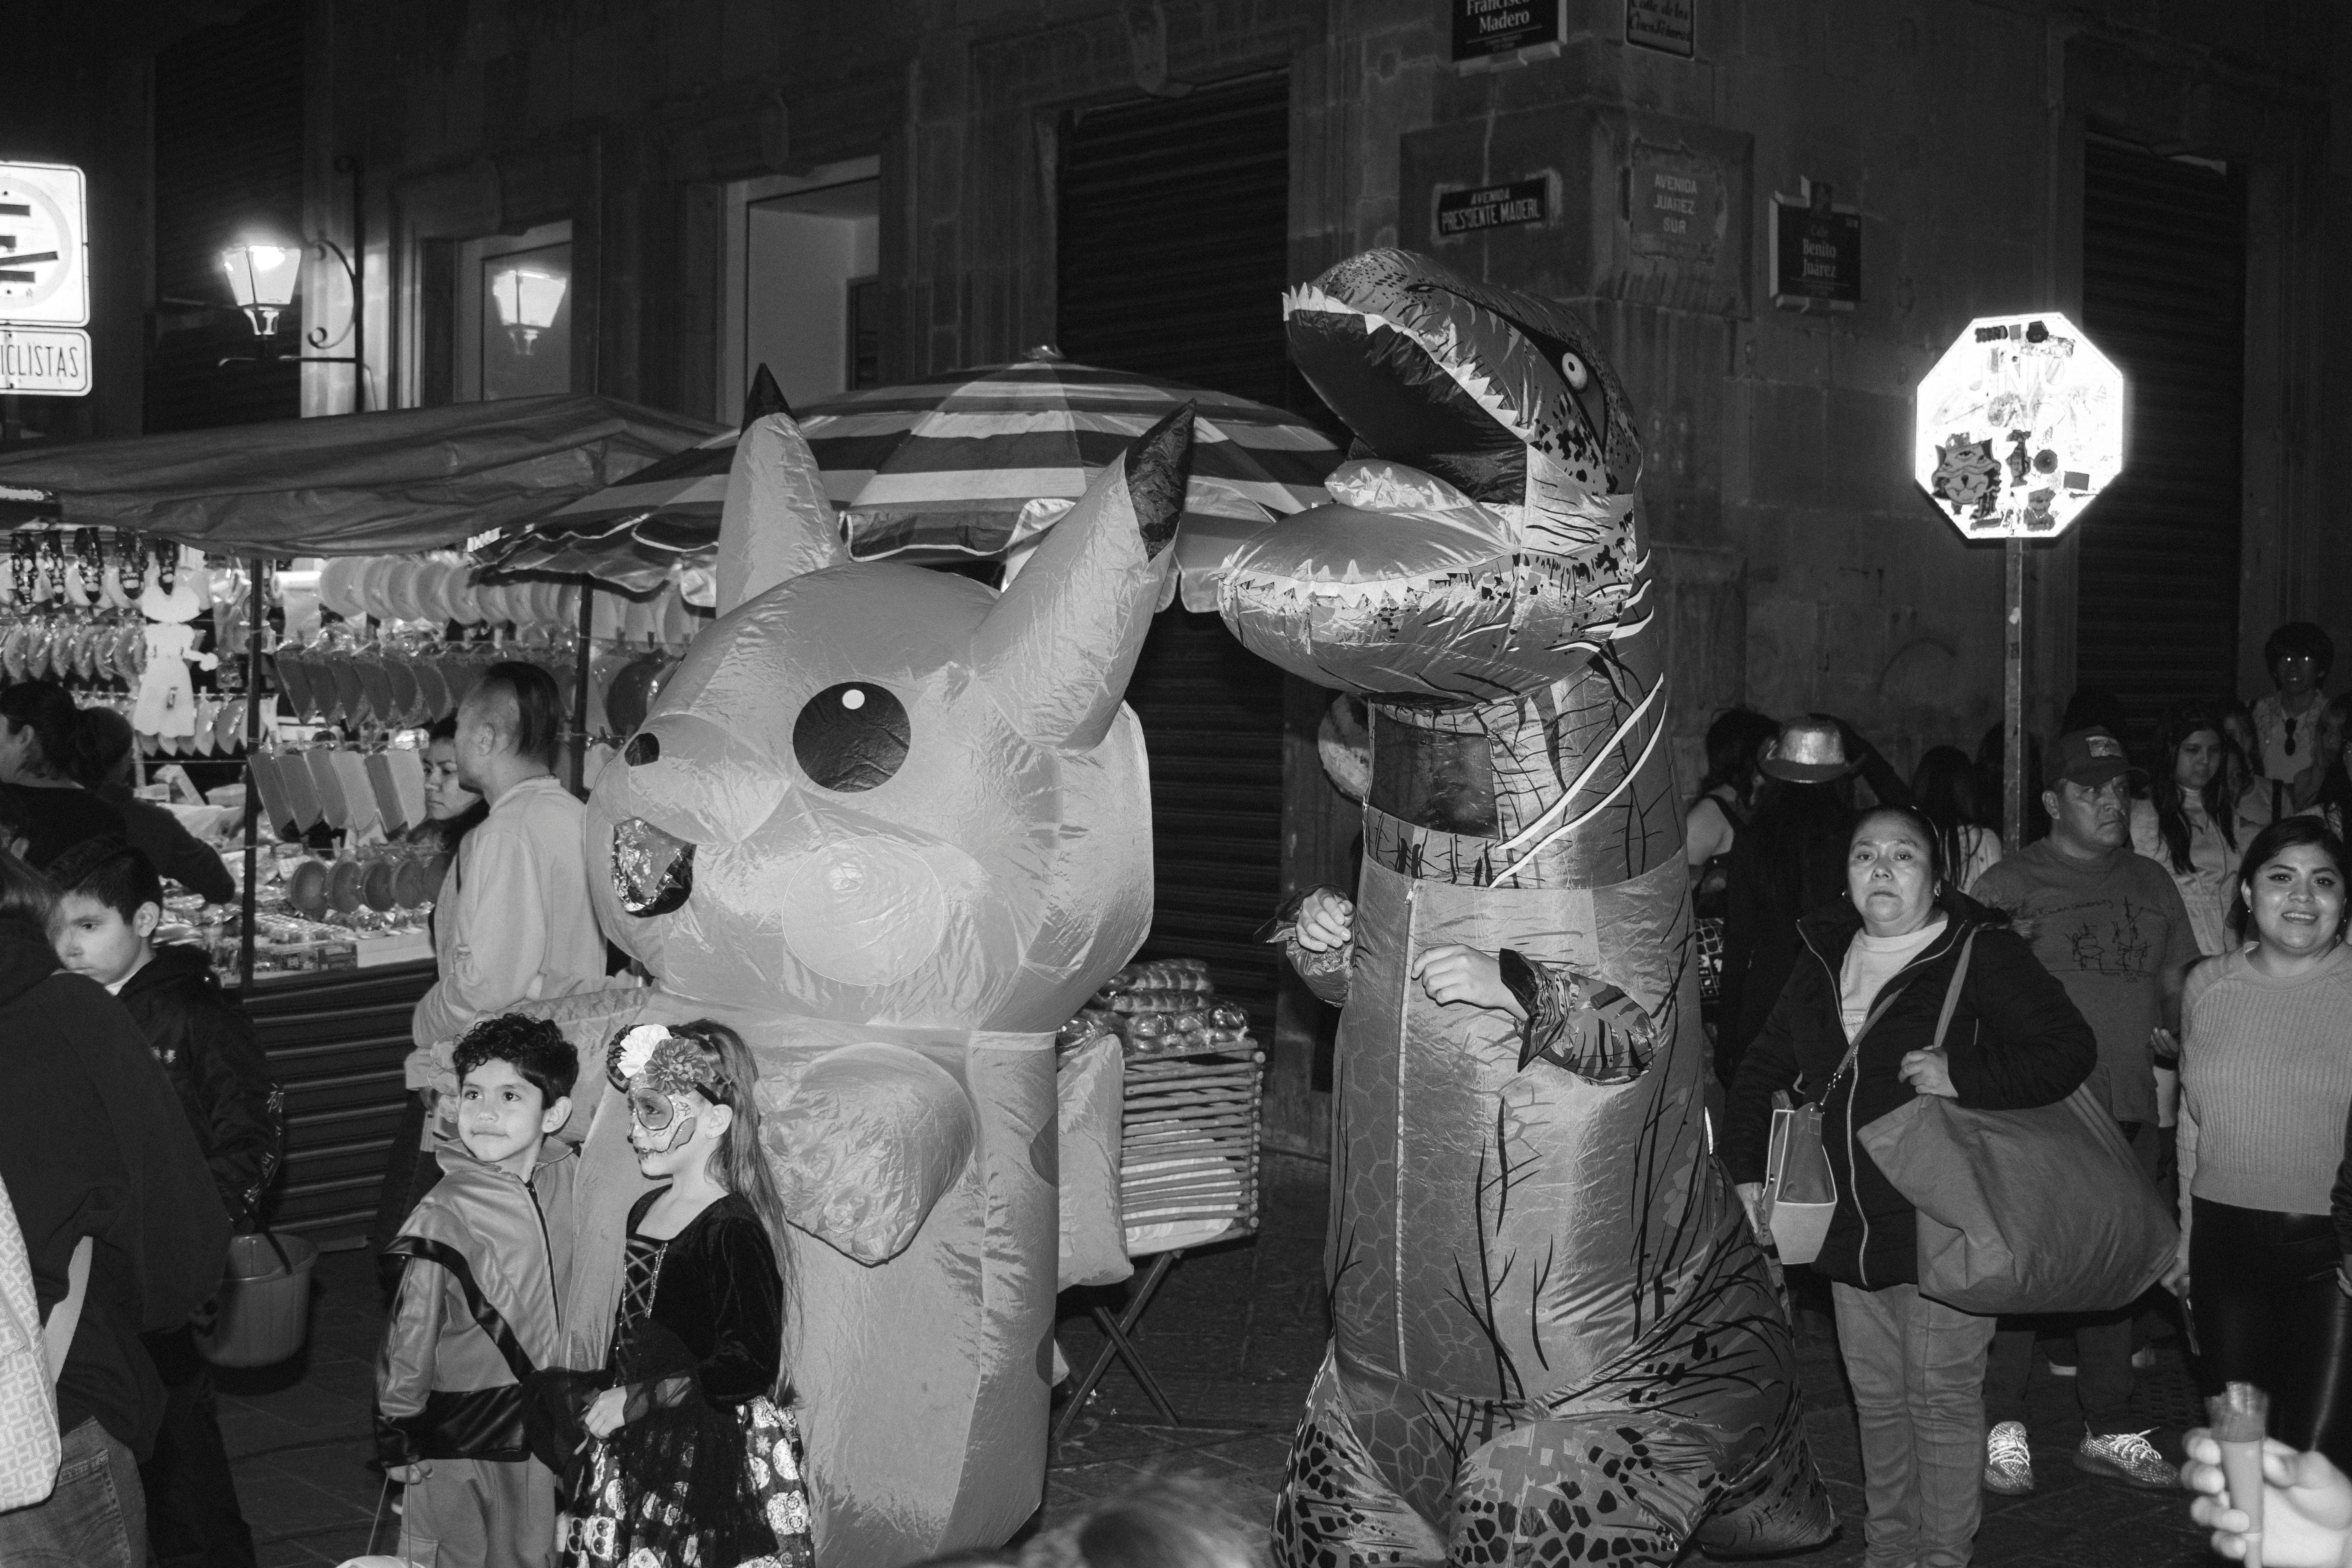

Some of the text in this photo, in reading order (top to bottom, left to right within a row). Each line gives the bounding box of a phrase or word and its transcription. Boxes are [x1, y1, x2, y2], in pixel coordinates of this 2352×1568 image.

[1466, 0, 1530, 16] Francis
[1479, 10, 1530, 34] Madero
[1654, 173, 1698, 194] AVENIDA
[1471, 187, 1510, 205] AVENIDA
[1653, 194, 1695, 215] JUAREZ
[1663, 216, 1686, 234] SUR
[1802, 238, 1837, 259] Benito
[1802, 257, 1837, 278] Juárez
[1961, 352, 2072, 398] UNO
